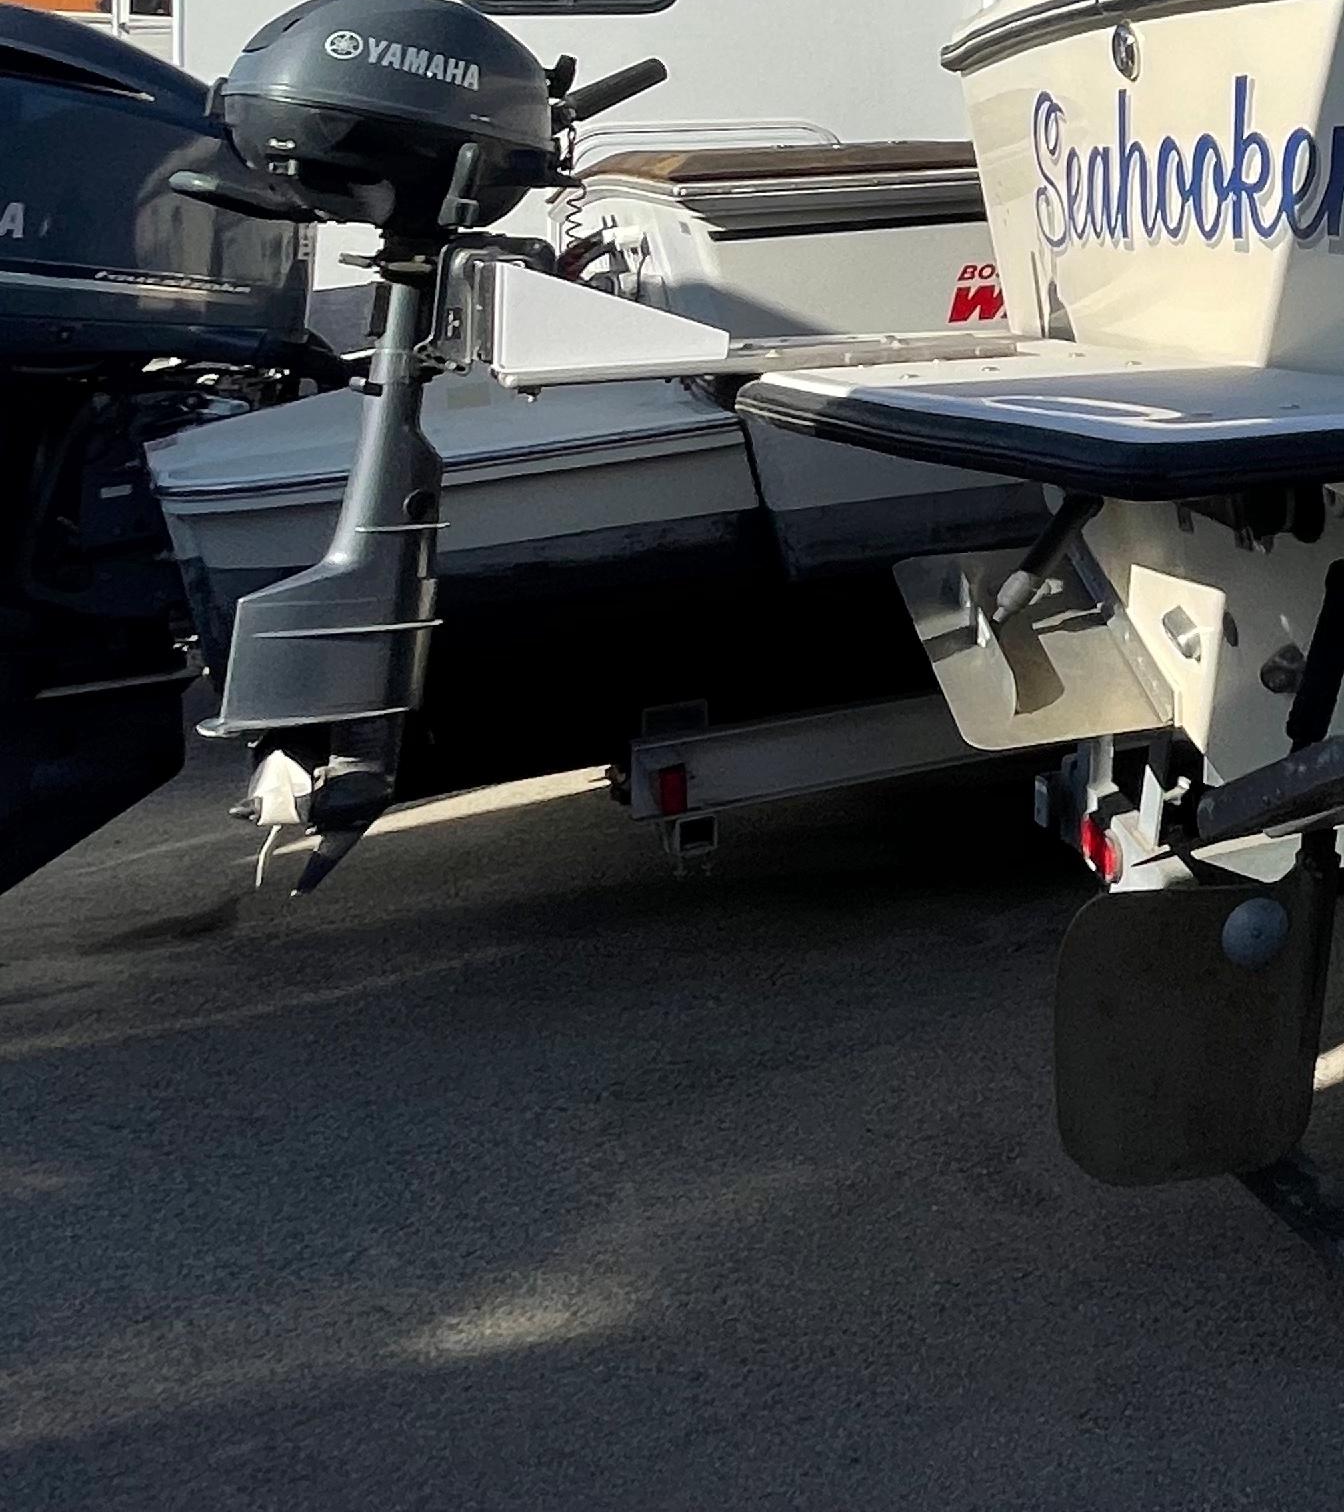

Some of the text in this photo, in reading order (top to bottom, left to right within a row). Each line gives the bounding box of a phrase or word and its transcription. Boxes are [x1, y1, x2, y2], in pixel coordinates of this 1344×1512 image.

[368, 37, 480, 91] YAMAHA
[957, 263, 1000, 282] BO
[948, 284, 1008, 323] W
